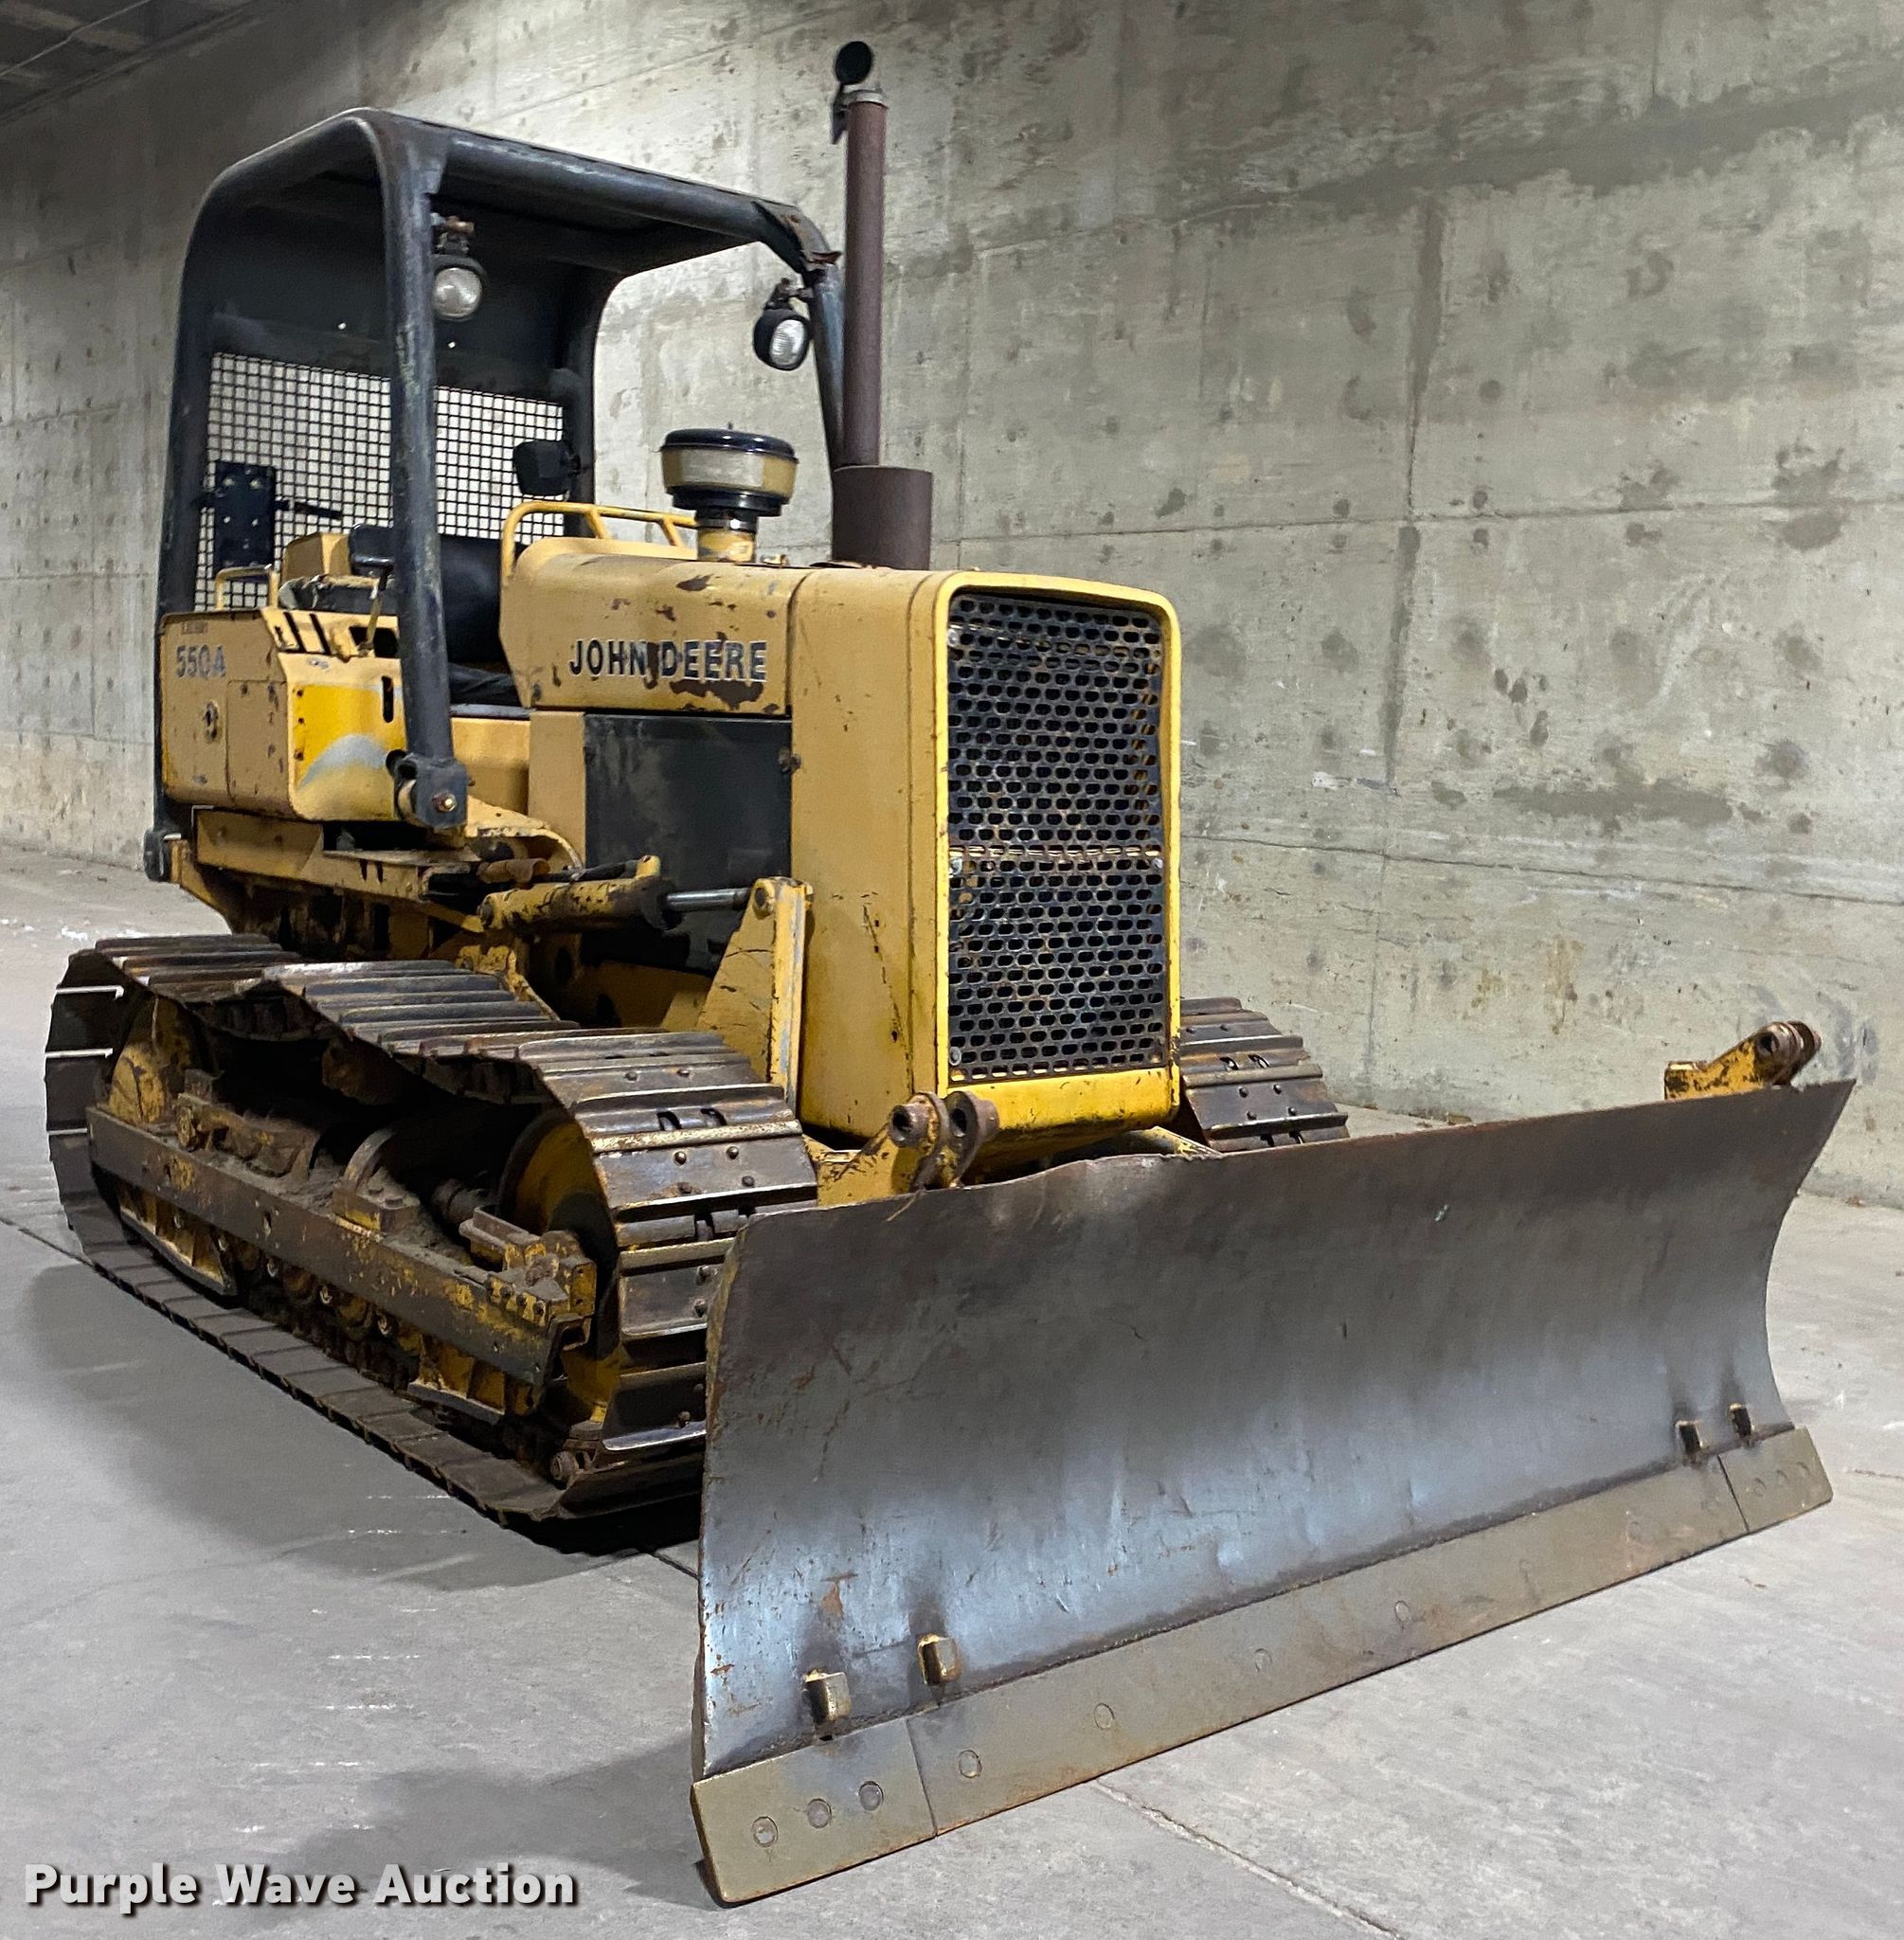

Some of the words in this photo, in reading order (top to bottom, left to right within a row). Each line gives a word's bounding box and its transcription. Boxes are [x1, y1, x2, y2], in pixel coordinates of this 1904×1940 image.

[175, 644, 226, 678] 550A
[569, 638, 648, 677] JOHN
[658, 638, 768, 682] DEERE
